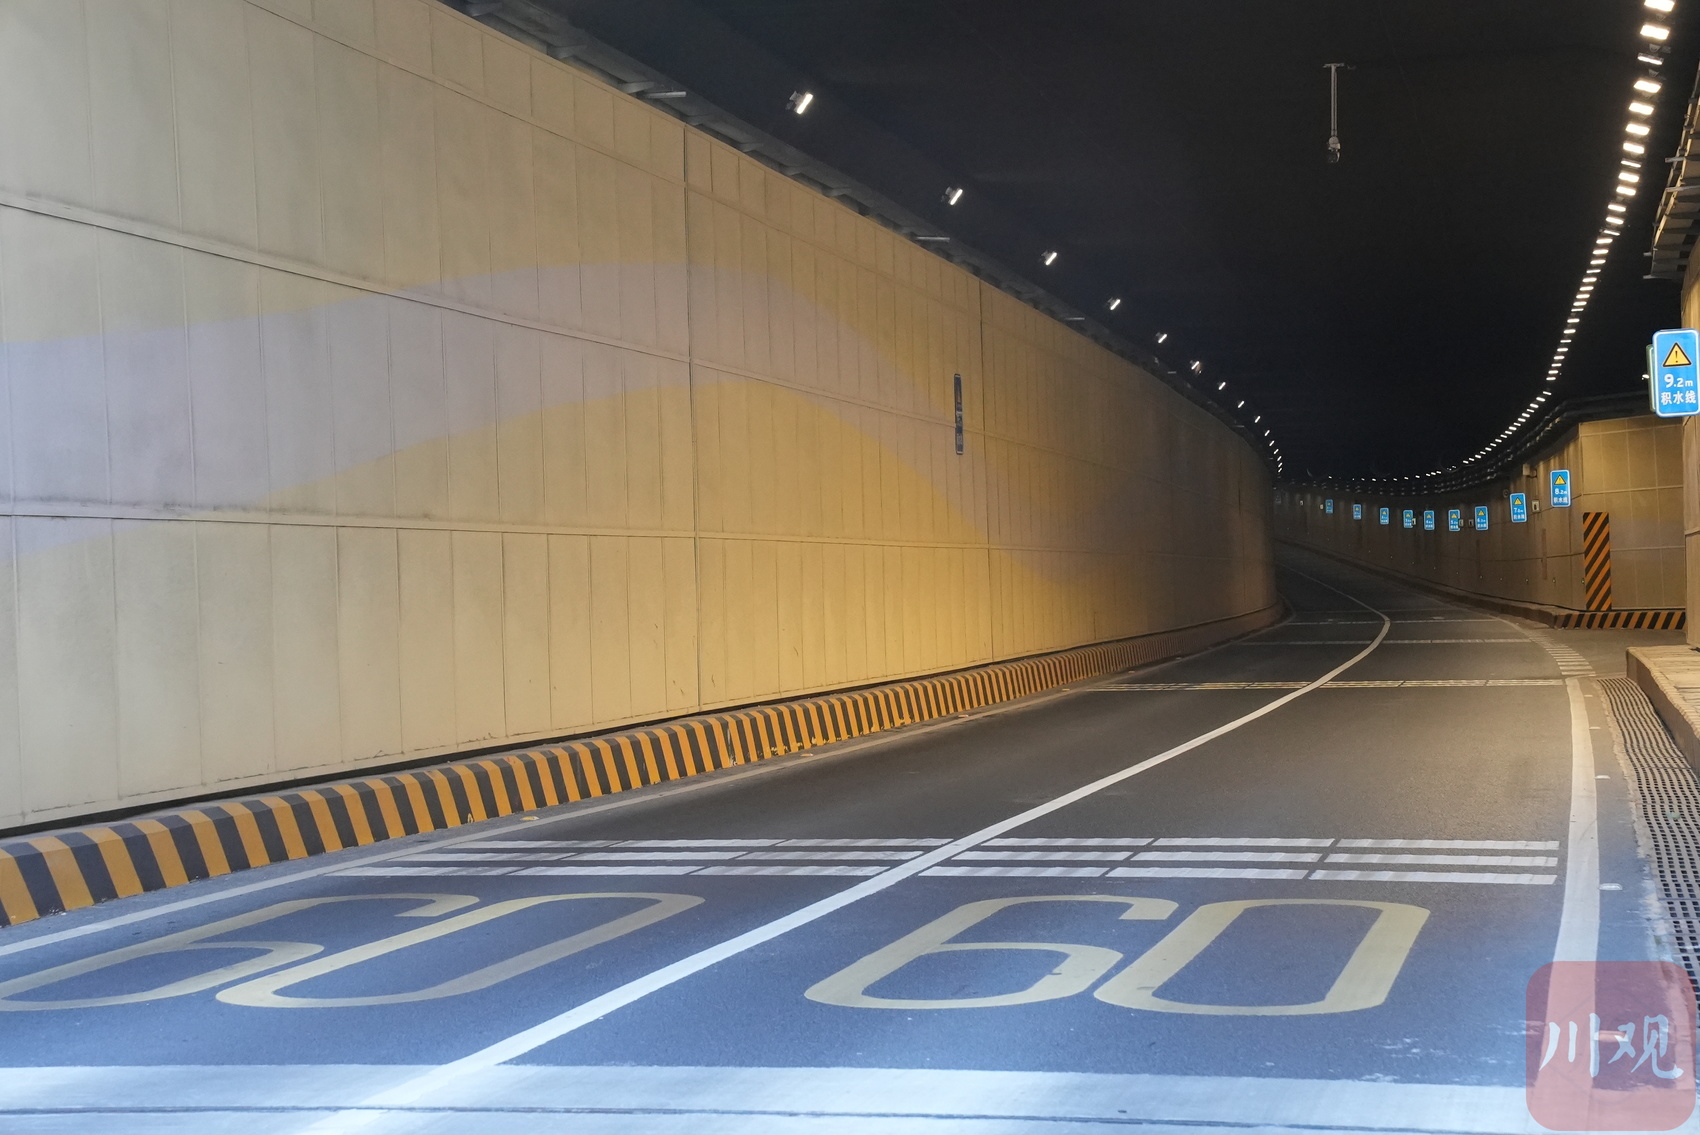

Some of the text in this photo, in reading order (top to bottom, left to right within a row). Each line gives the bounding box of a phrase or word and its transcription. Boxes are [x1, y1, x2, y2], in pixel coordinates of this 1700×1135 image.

[1661, 390, 1697, 405] 积水线
[1664, 373, 1693, 388] 9.2m
[0, 892, 706, 1012] 60
[804, 894, 1431, 1017] 60
